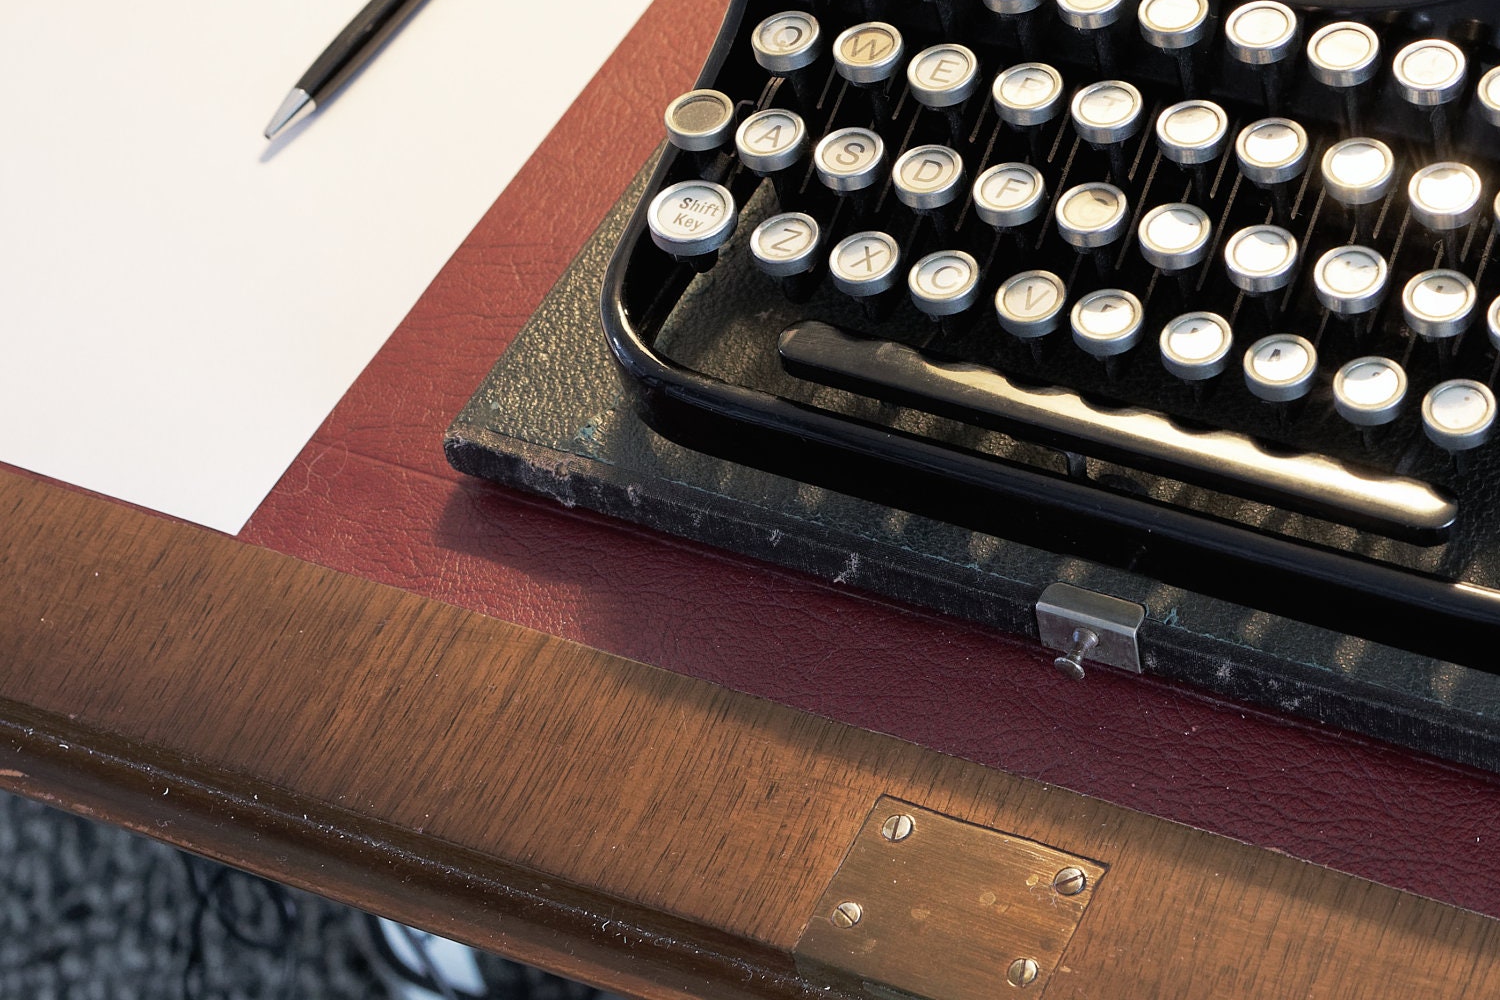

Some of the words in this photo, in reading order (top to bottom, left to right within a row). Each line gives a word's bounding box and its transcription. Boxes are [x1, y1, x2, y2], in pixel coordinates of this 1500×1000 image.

[773, 25, 803, 50] Q
[848, 35, 890, 60] W
[929, 59, 960, 83] E
[754, 125, 782, 148] A
[836, 143, 865, 165] S
[912, 159, 944, 182] D
[995, 177, 1028, 199] F
[673, 213, 704, 232] Key
[679, 197, 720, 217] Shift
[770, 228, 804, 252] Z
[850, 246, 884, 272] X
[931, 266, 962, 289] C
[1025, 285, 1050, 311] V
